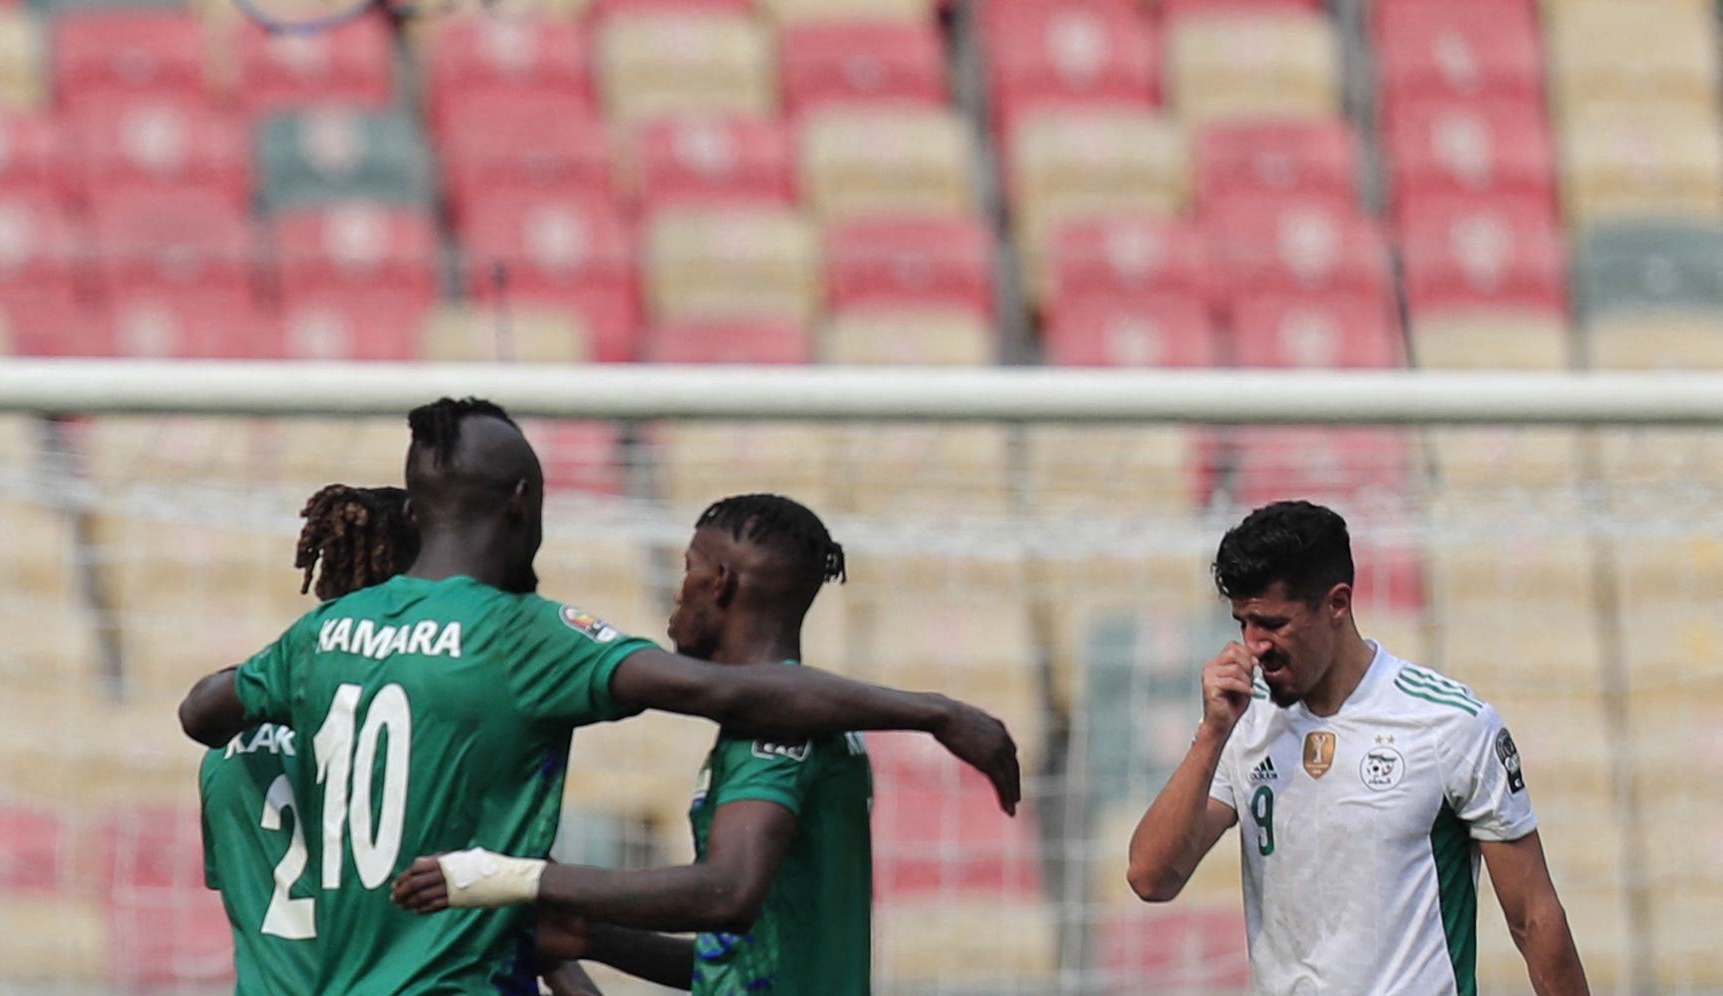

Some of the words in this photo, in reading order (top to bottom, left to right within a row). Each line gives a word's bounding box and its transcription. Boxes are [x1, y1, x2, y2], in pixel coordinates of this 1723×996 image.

[316, 617, 461, 659] KAMARA
[313, 683, 412, 889] 10
[1251, 785, 1275, 856] 9
[261, 774, 316, 939] 2
